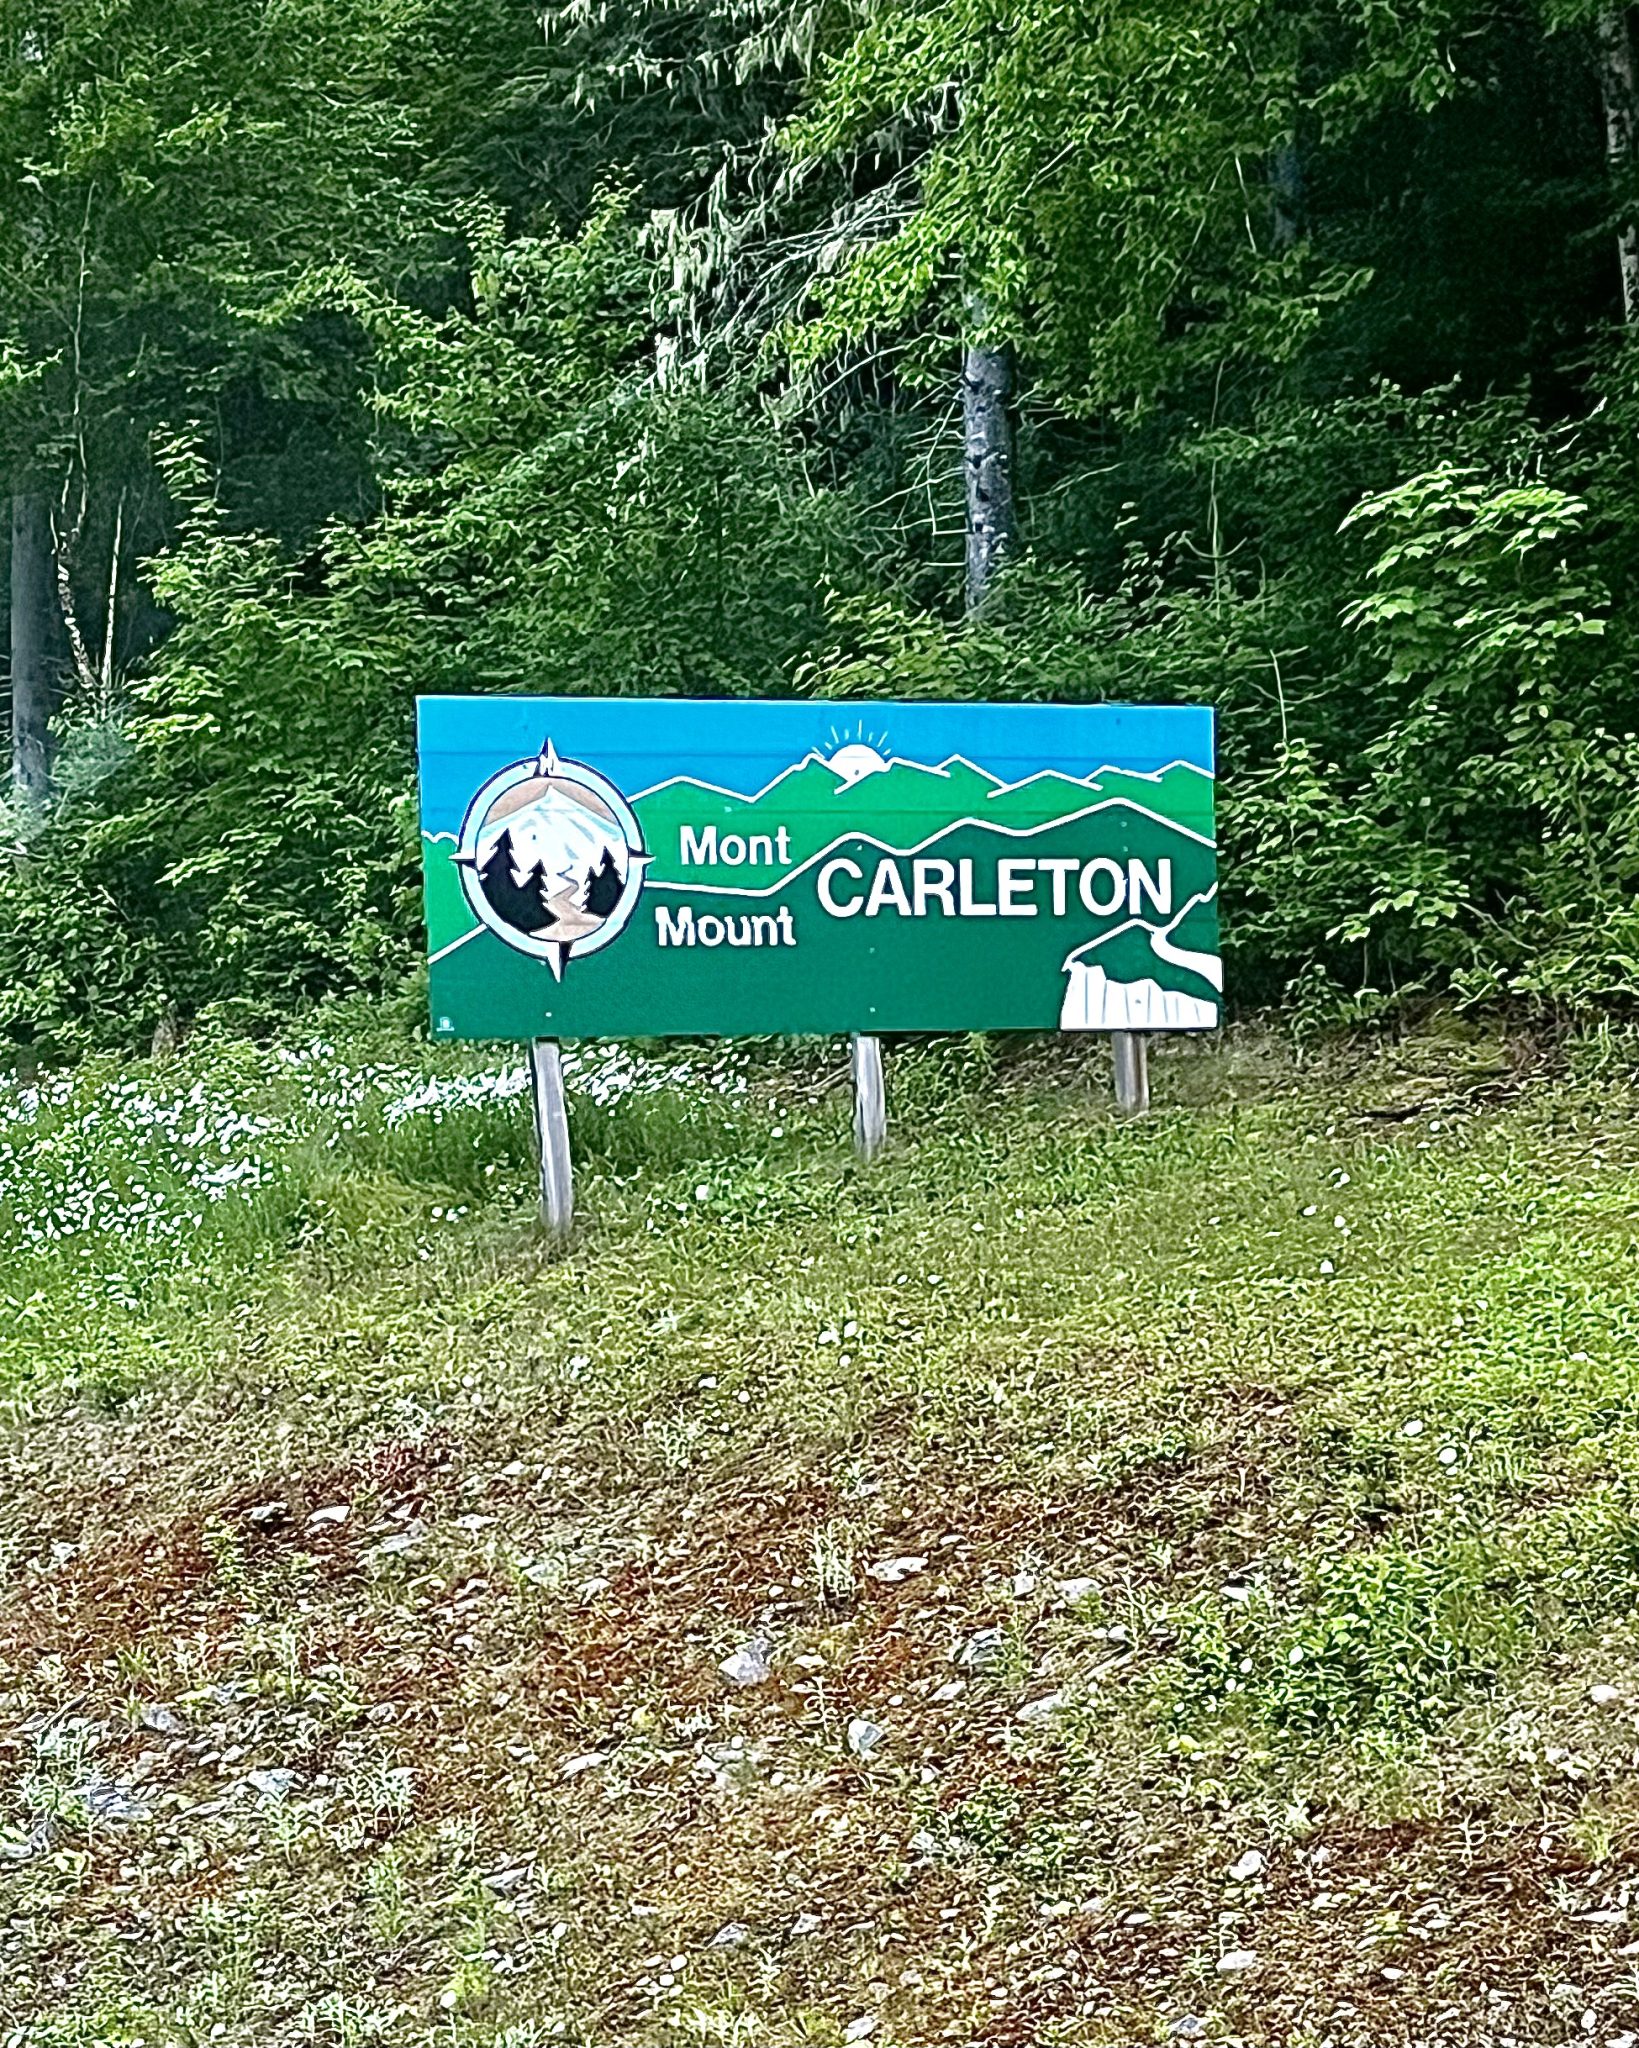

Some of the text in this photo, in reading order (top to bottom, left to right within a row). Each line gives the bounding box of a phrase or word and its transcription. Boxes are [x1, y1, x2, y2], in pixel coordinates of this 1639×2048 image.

[680, 825, 792, 865] Mont
[817, 857, 1172, 917] CARLETON
[655, 906, 797, 947] Mount
